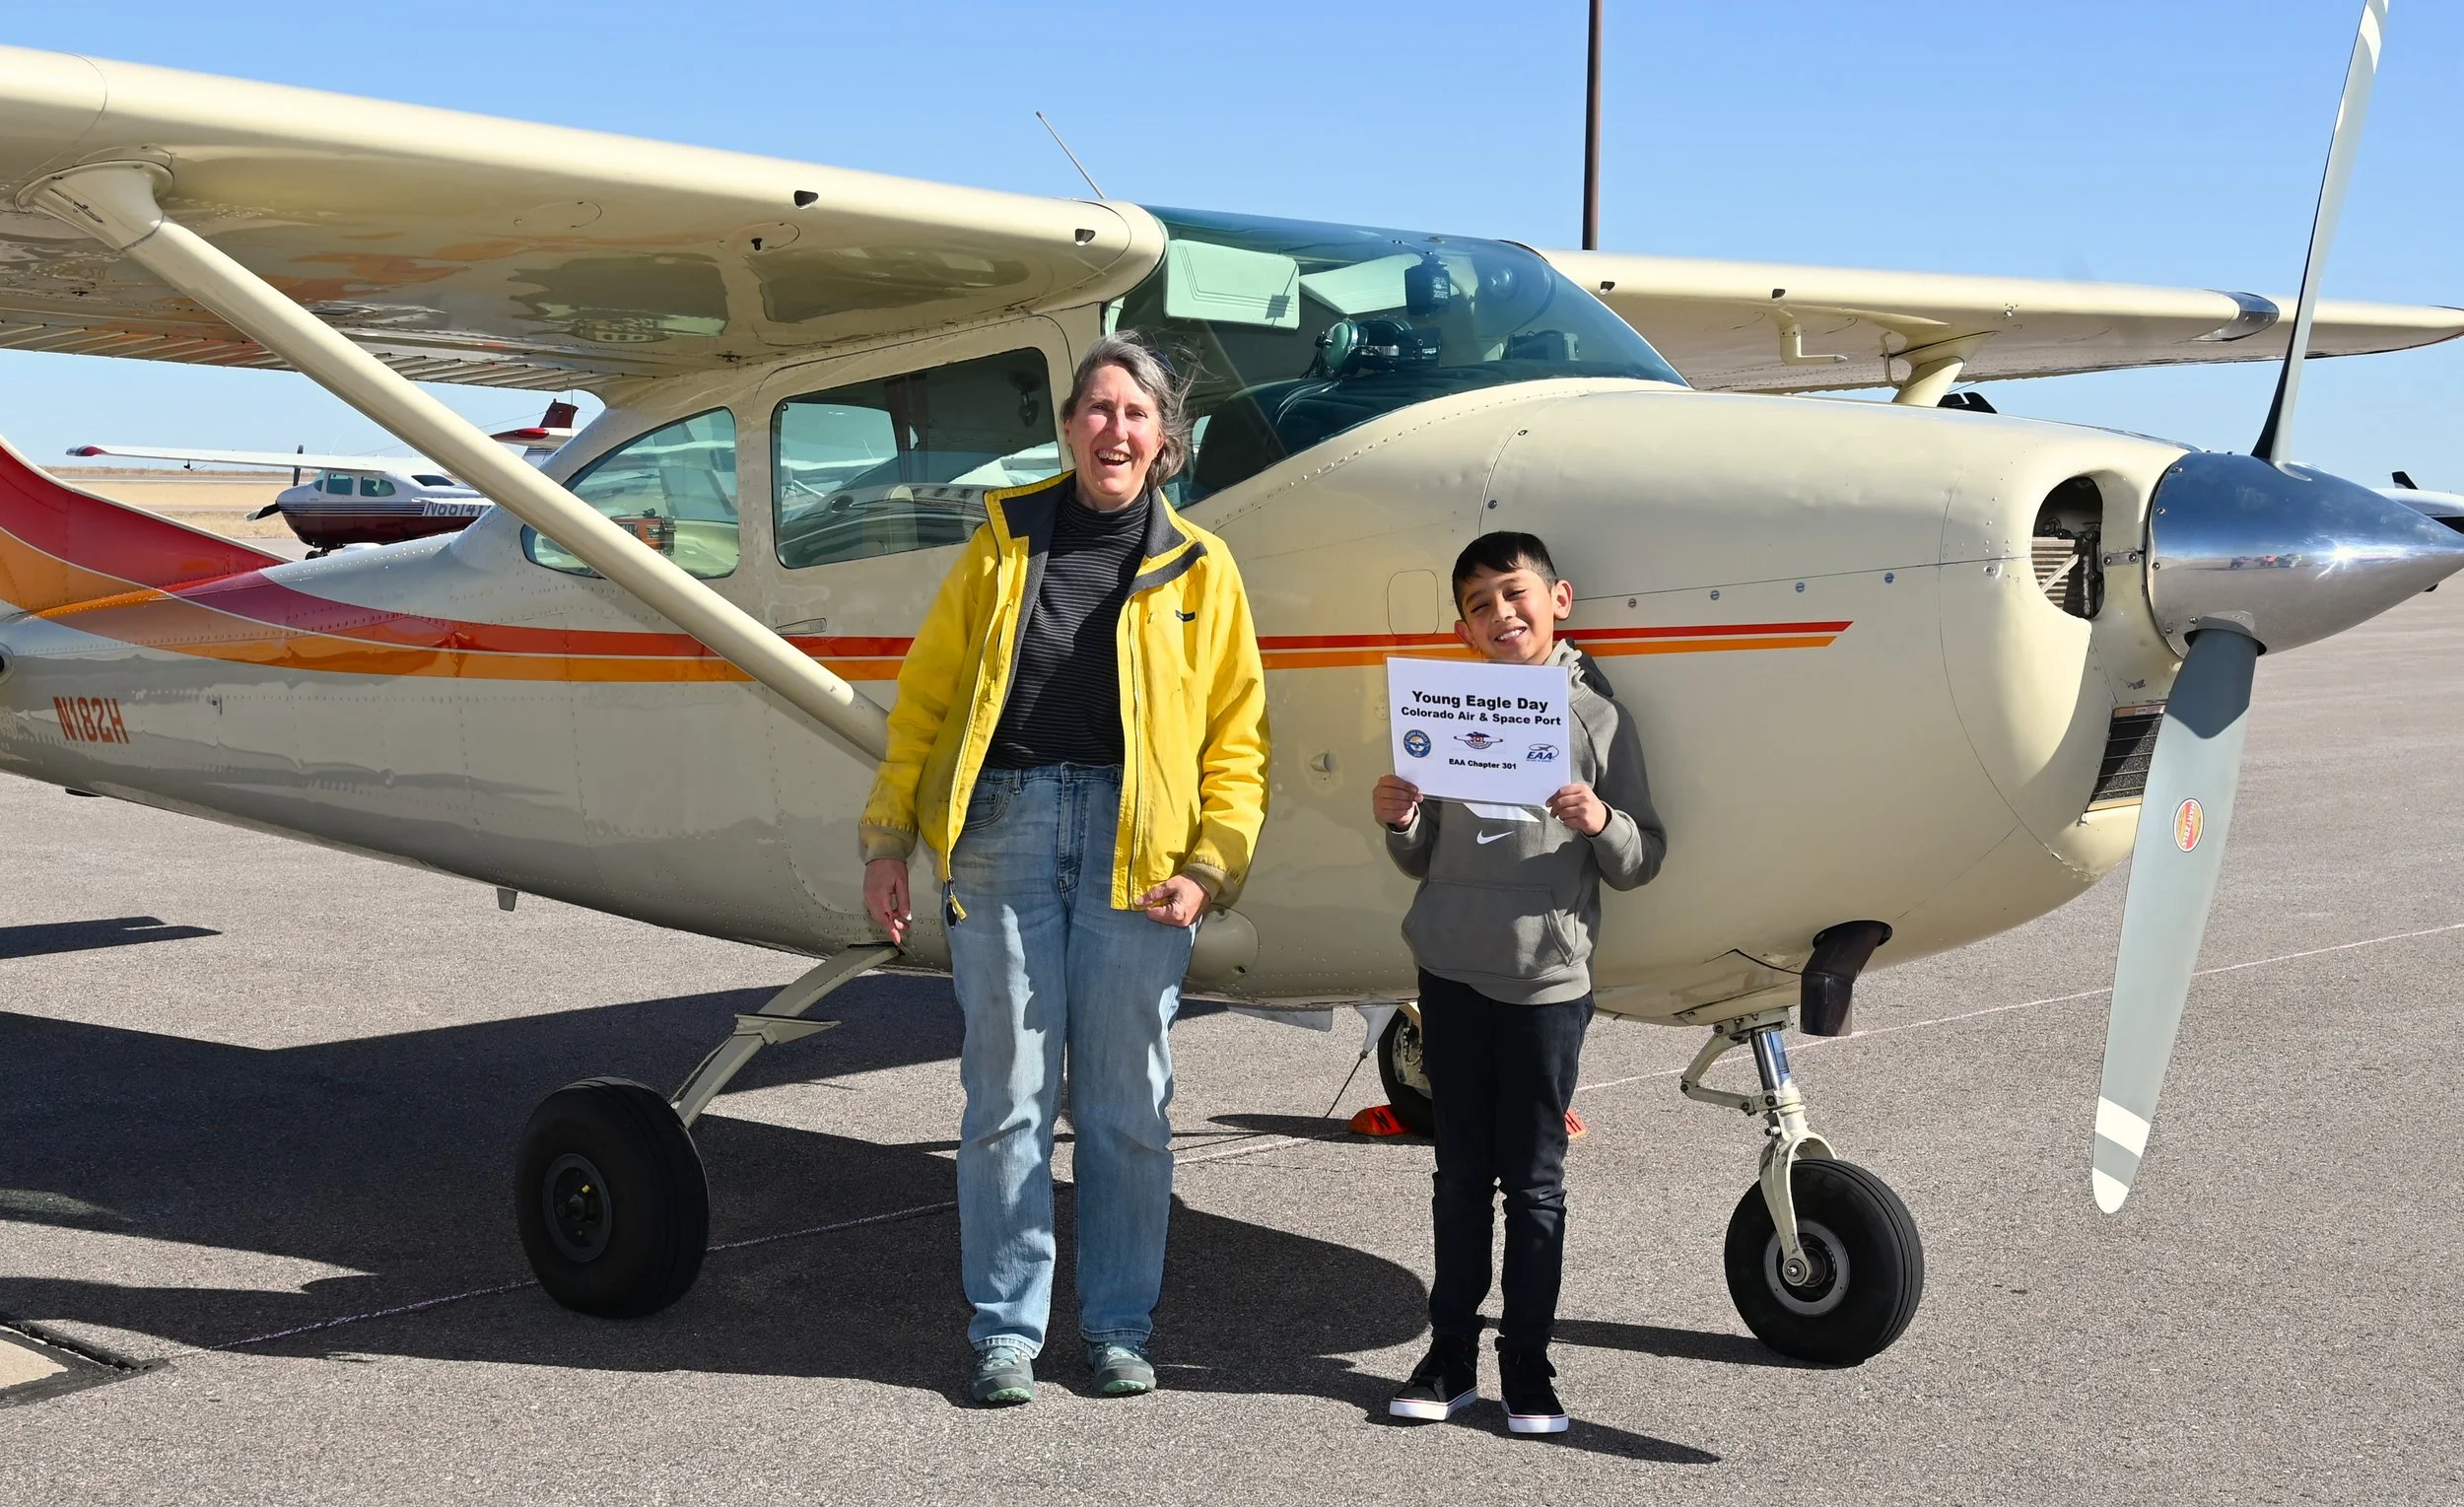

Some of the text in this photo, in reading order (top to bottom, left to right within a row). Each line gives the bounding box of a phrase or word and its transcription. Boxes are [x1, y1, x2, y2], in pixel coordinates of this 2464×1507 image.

[1411, 690, 1548, 714] Young Eagle Day
[53, 696, 130, 744] N182H
[1401, 707, 1561, 725] Colorado Air & Space Port
[1468, 760, 1500, 769] Chapter
[1526, 751, 1553, 760] EAA
